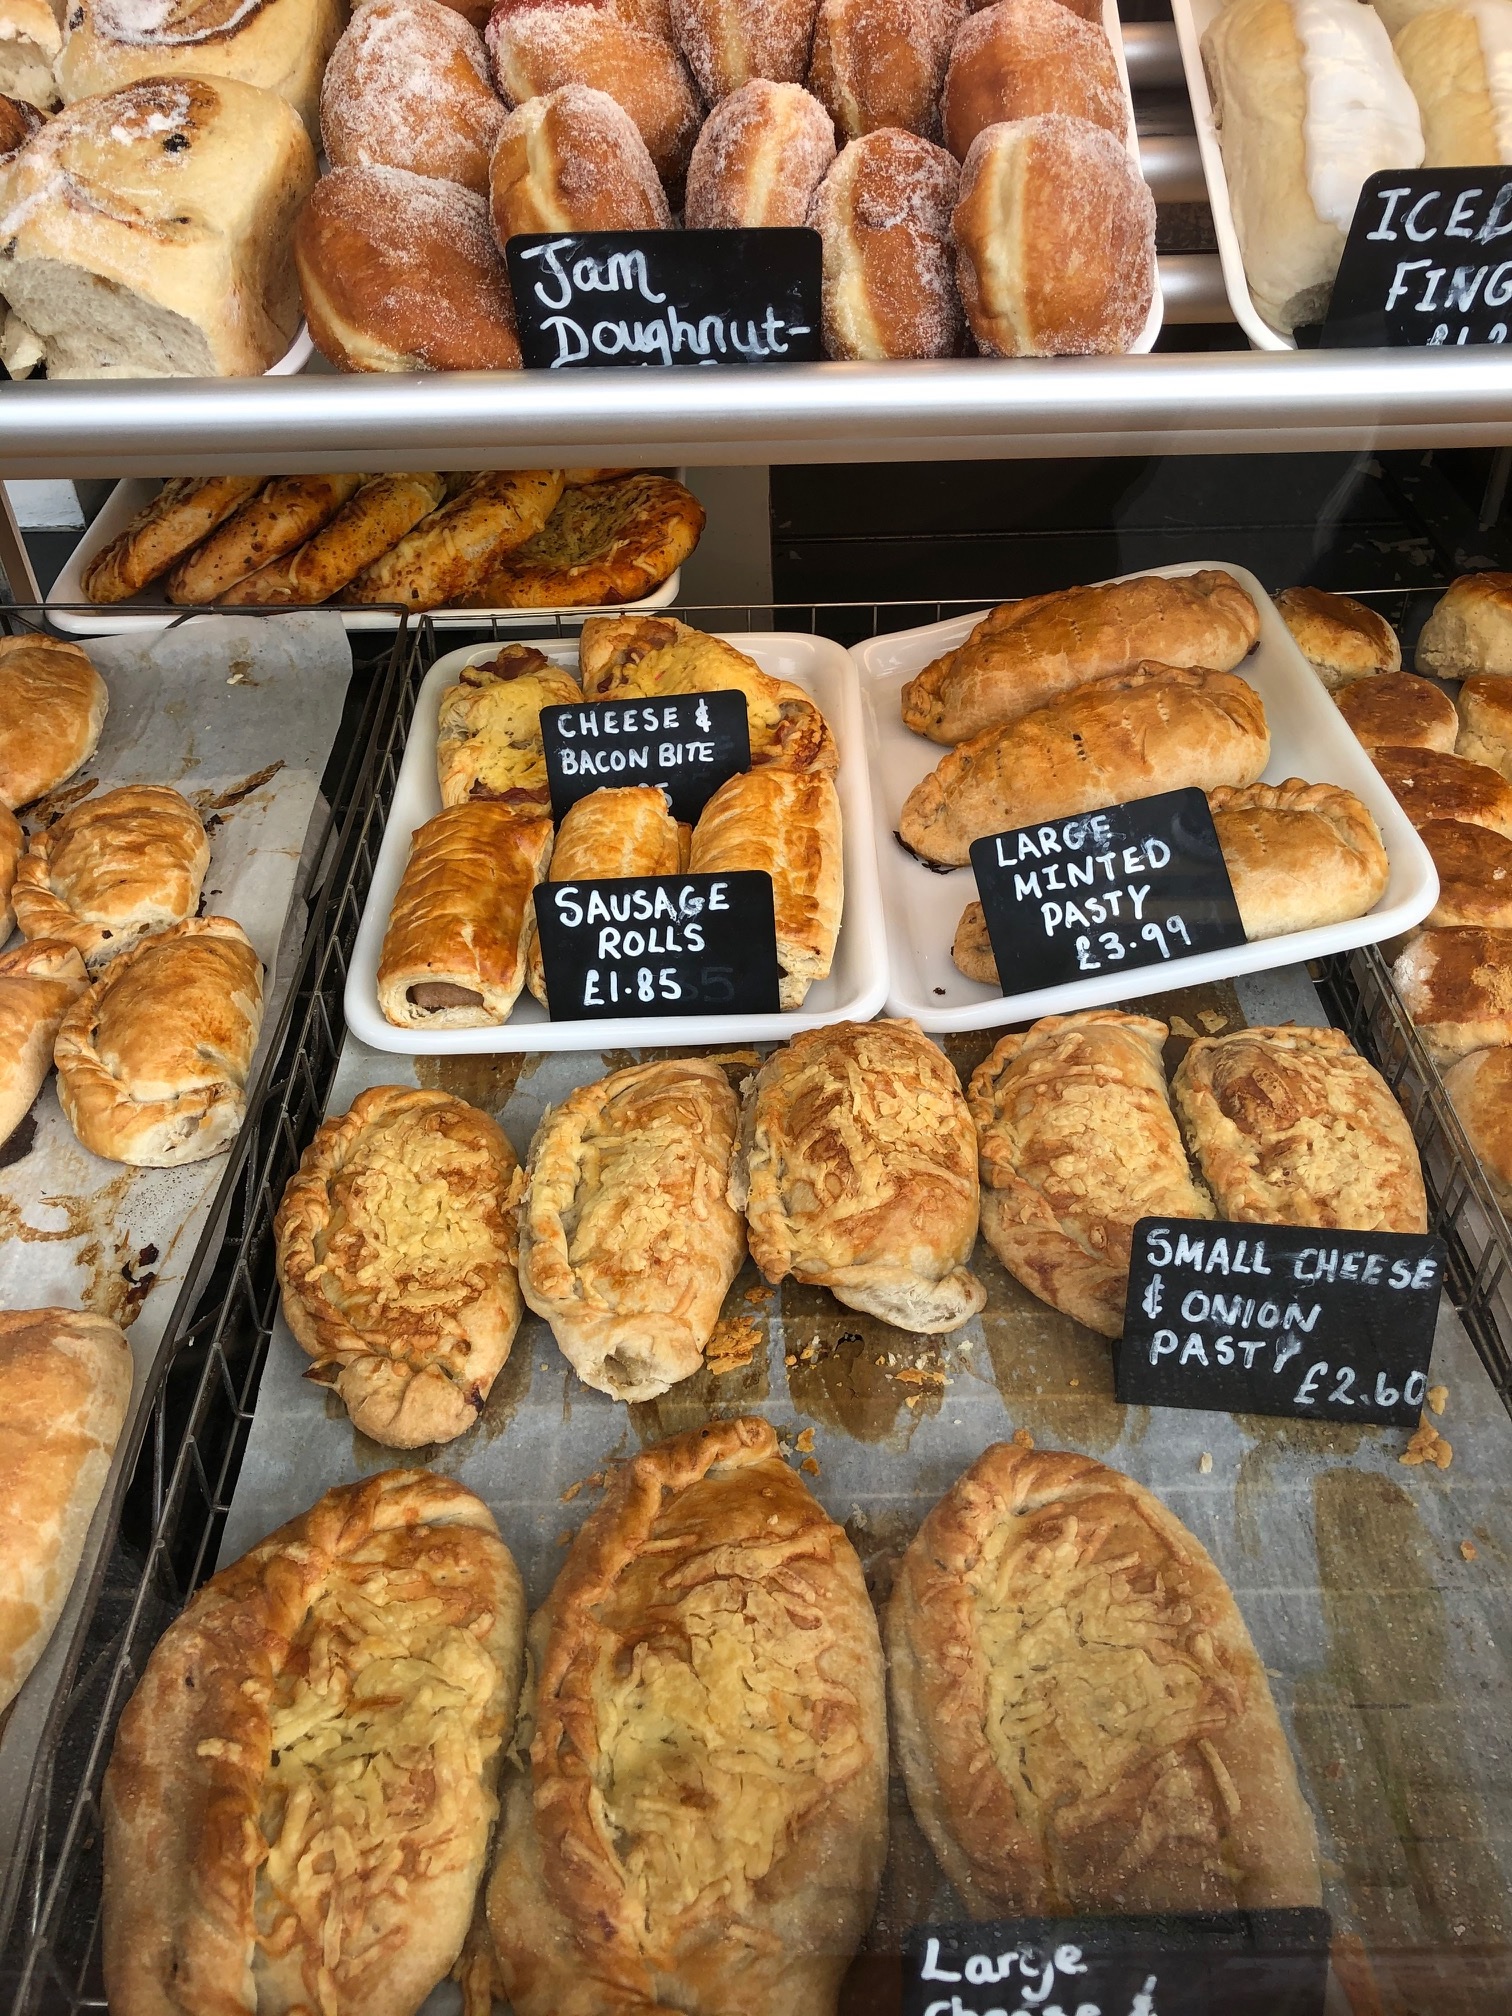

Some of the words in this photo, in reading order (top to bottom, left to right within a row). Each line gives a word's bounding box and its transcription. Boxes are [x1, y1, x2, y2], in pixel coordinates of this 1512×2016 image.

[1366, 182, 1512, 245] ICED
[521, 238, 666, 310] Jam
[557, 706, 680, 738] CHEESE
[695, 698, 712, 733] &
[560, 748, 649, 775] BACON
[658, 741, 715, 768] BITE
[995, 814, 1111, 868] LARGE
[1013, 837, 1171, 902] MINTED
[554, 882, 730, 928] SAUSAGE
[1040, 884, 1151, 937] PASTY
[598, 922, 706, 960] ROLLS
[1075, 915, 1193, 971] £3.99
[583, 966, 682, 1007] £1.85
[1146, 1228, 1272, 1276] SMALL
[1293, 1247, 1438, 1290] CHEESE
[1180, 1289, 1322, 1333] ONION
[1147, 1329, 1302, 1374] PASTY
[1293, 1360, 1427, 1407] £2.60
[920, 1937, 1089, 2003] Large
